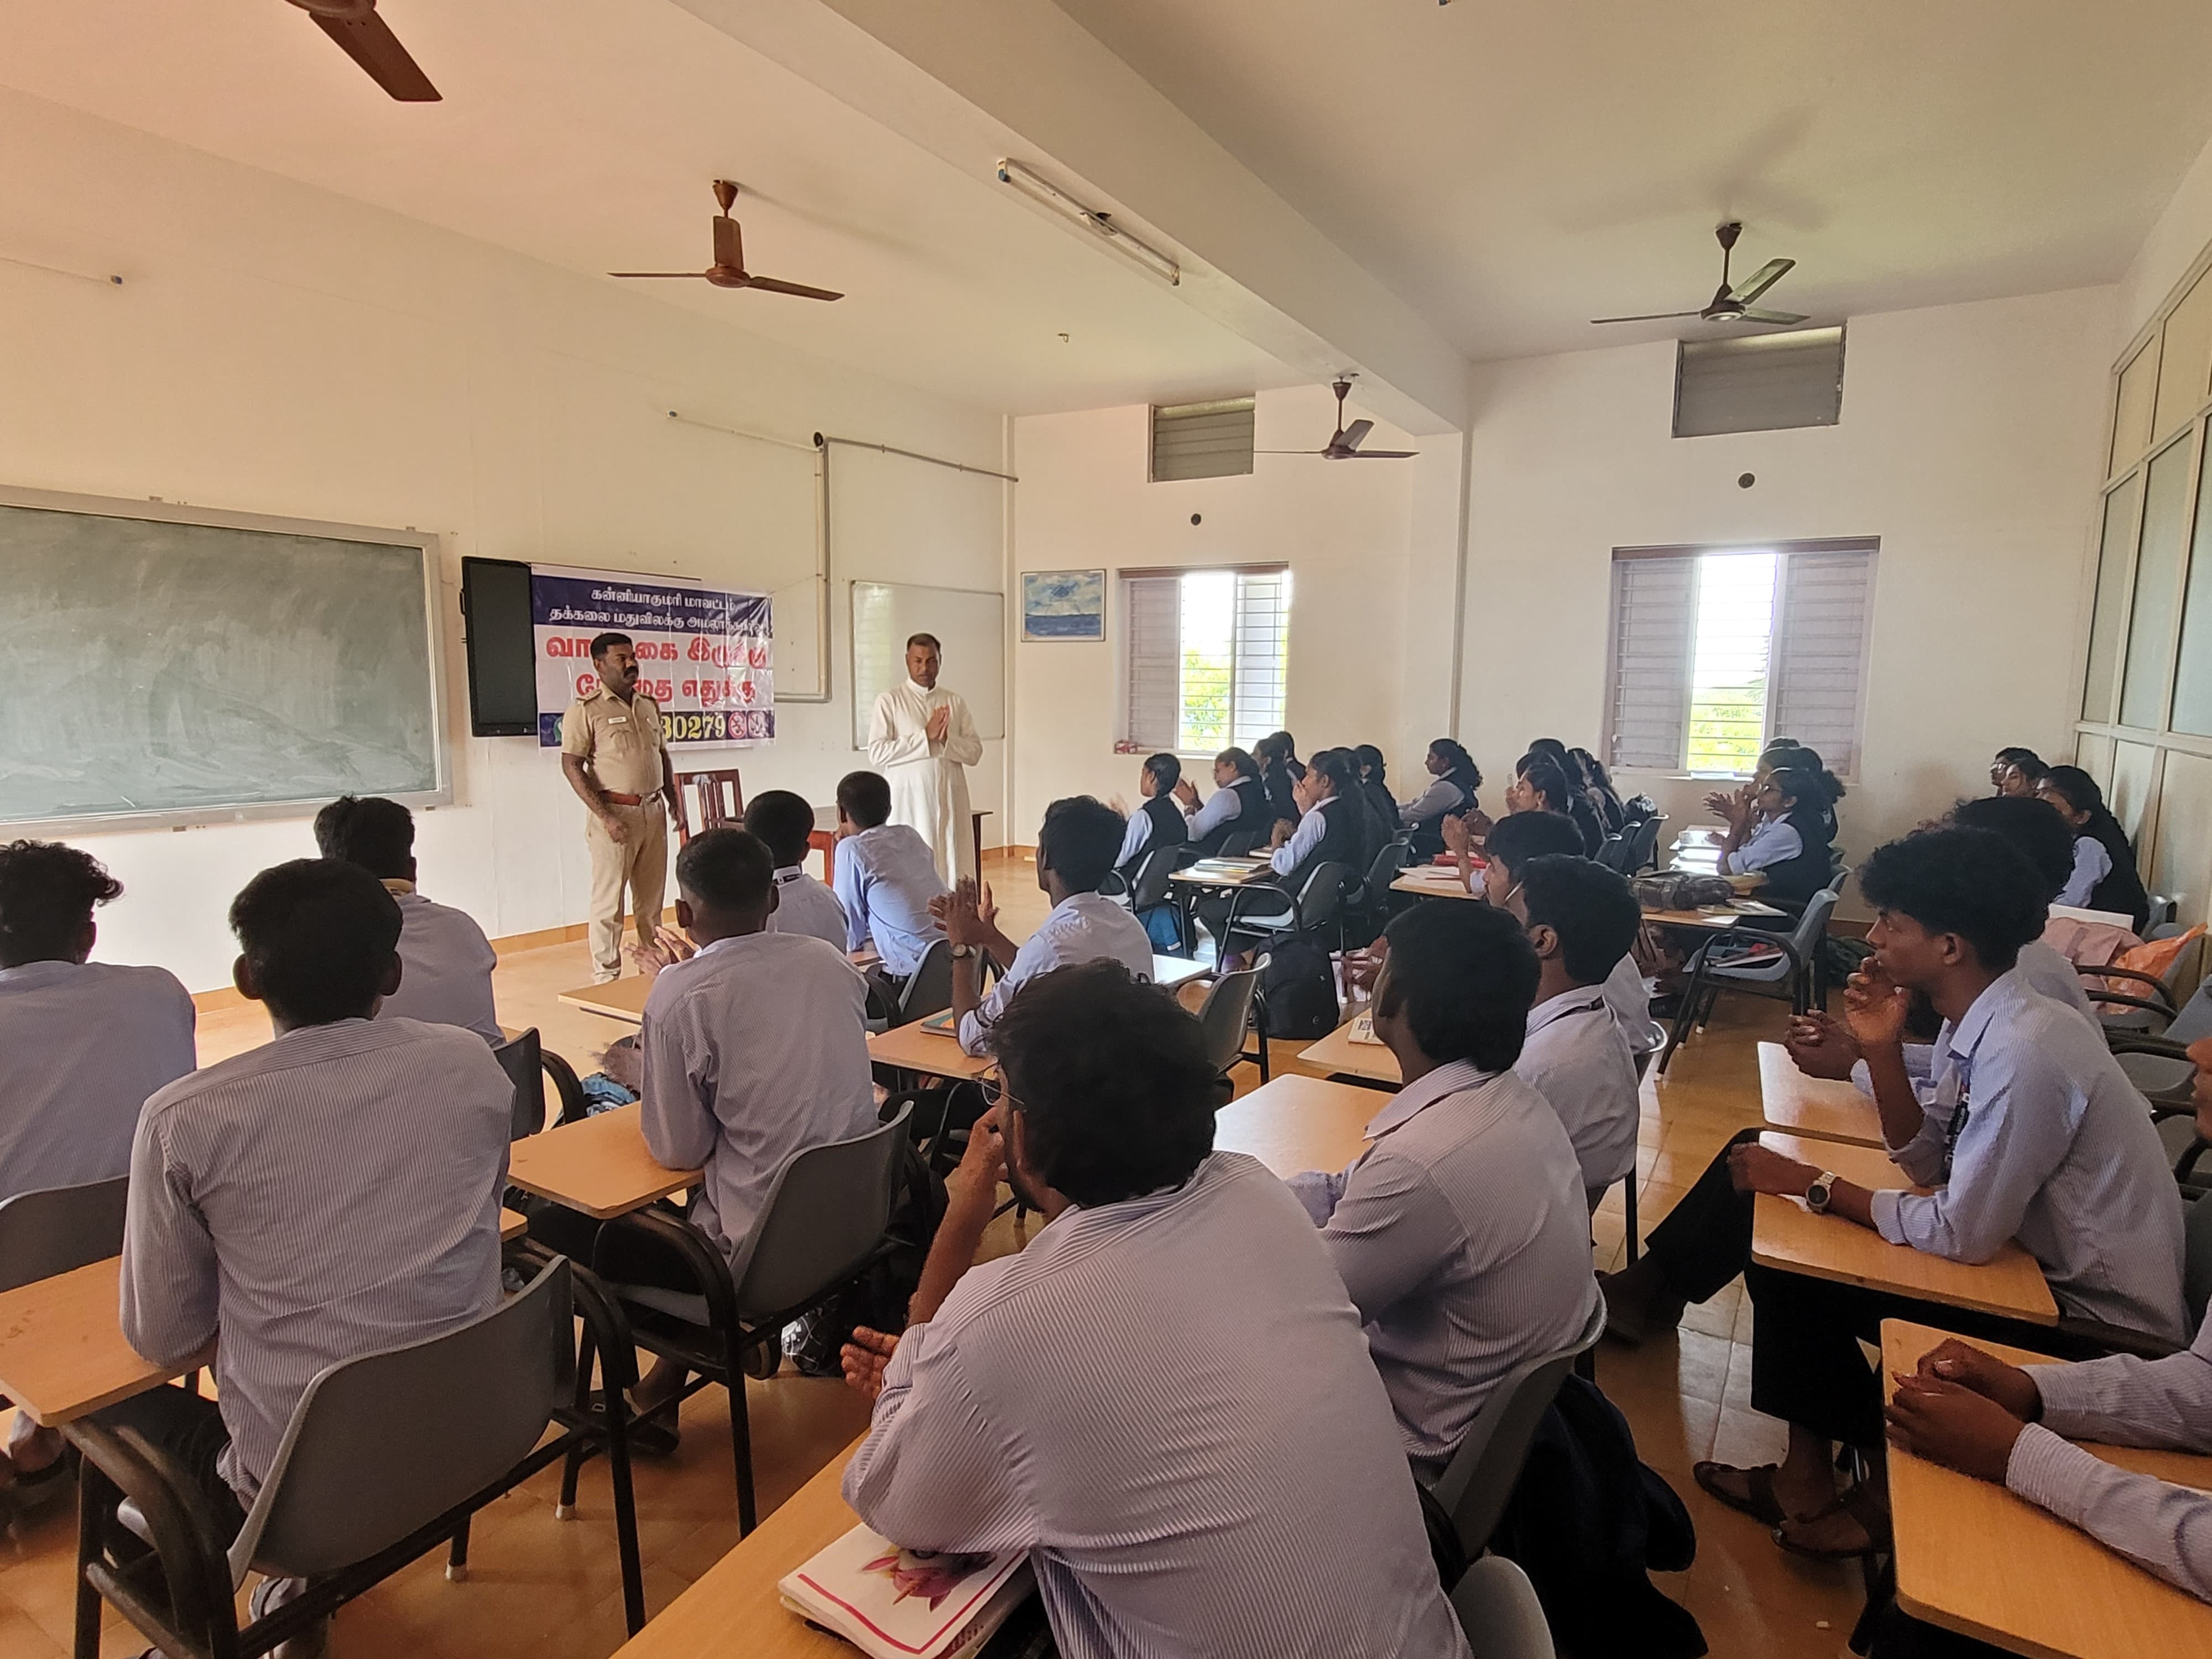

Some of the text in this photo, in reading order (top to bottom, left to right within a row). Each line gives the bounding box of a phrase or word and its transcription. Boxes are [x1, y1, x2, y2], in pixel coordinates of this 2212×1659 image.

[591, 586, 736, 611] கன்னியாகுமரி மாவட்டம்
[549, 604, 611, 623] தக்கலை
[614, 612, 685, 629] மதுவிலக்கு
